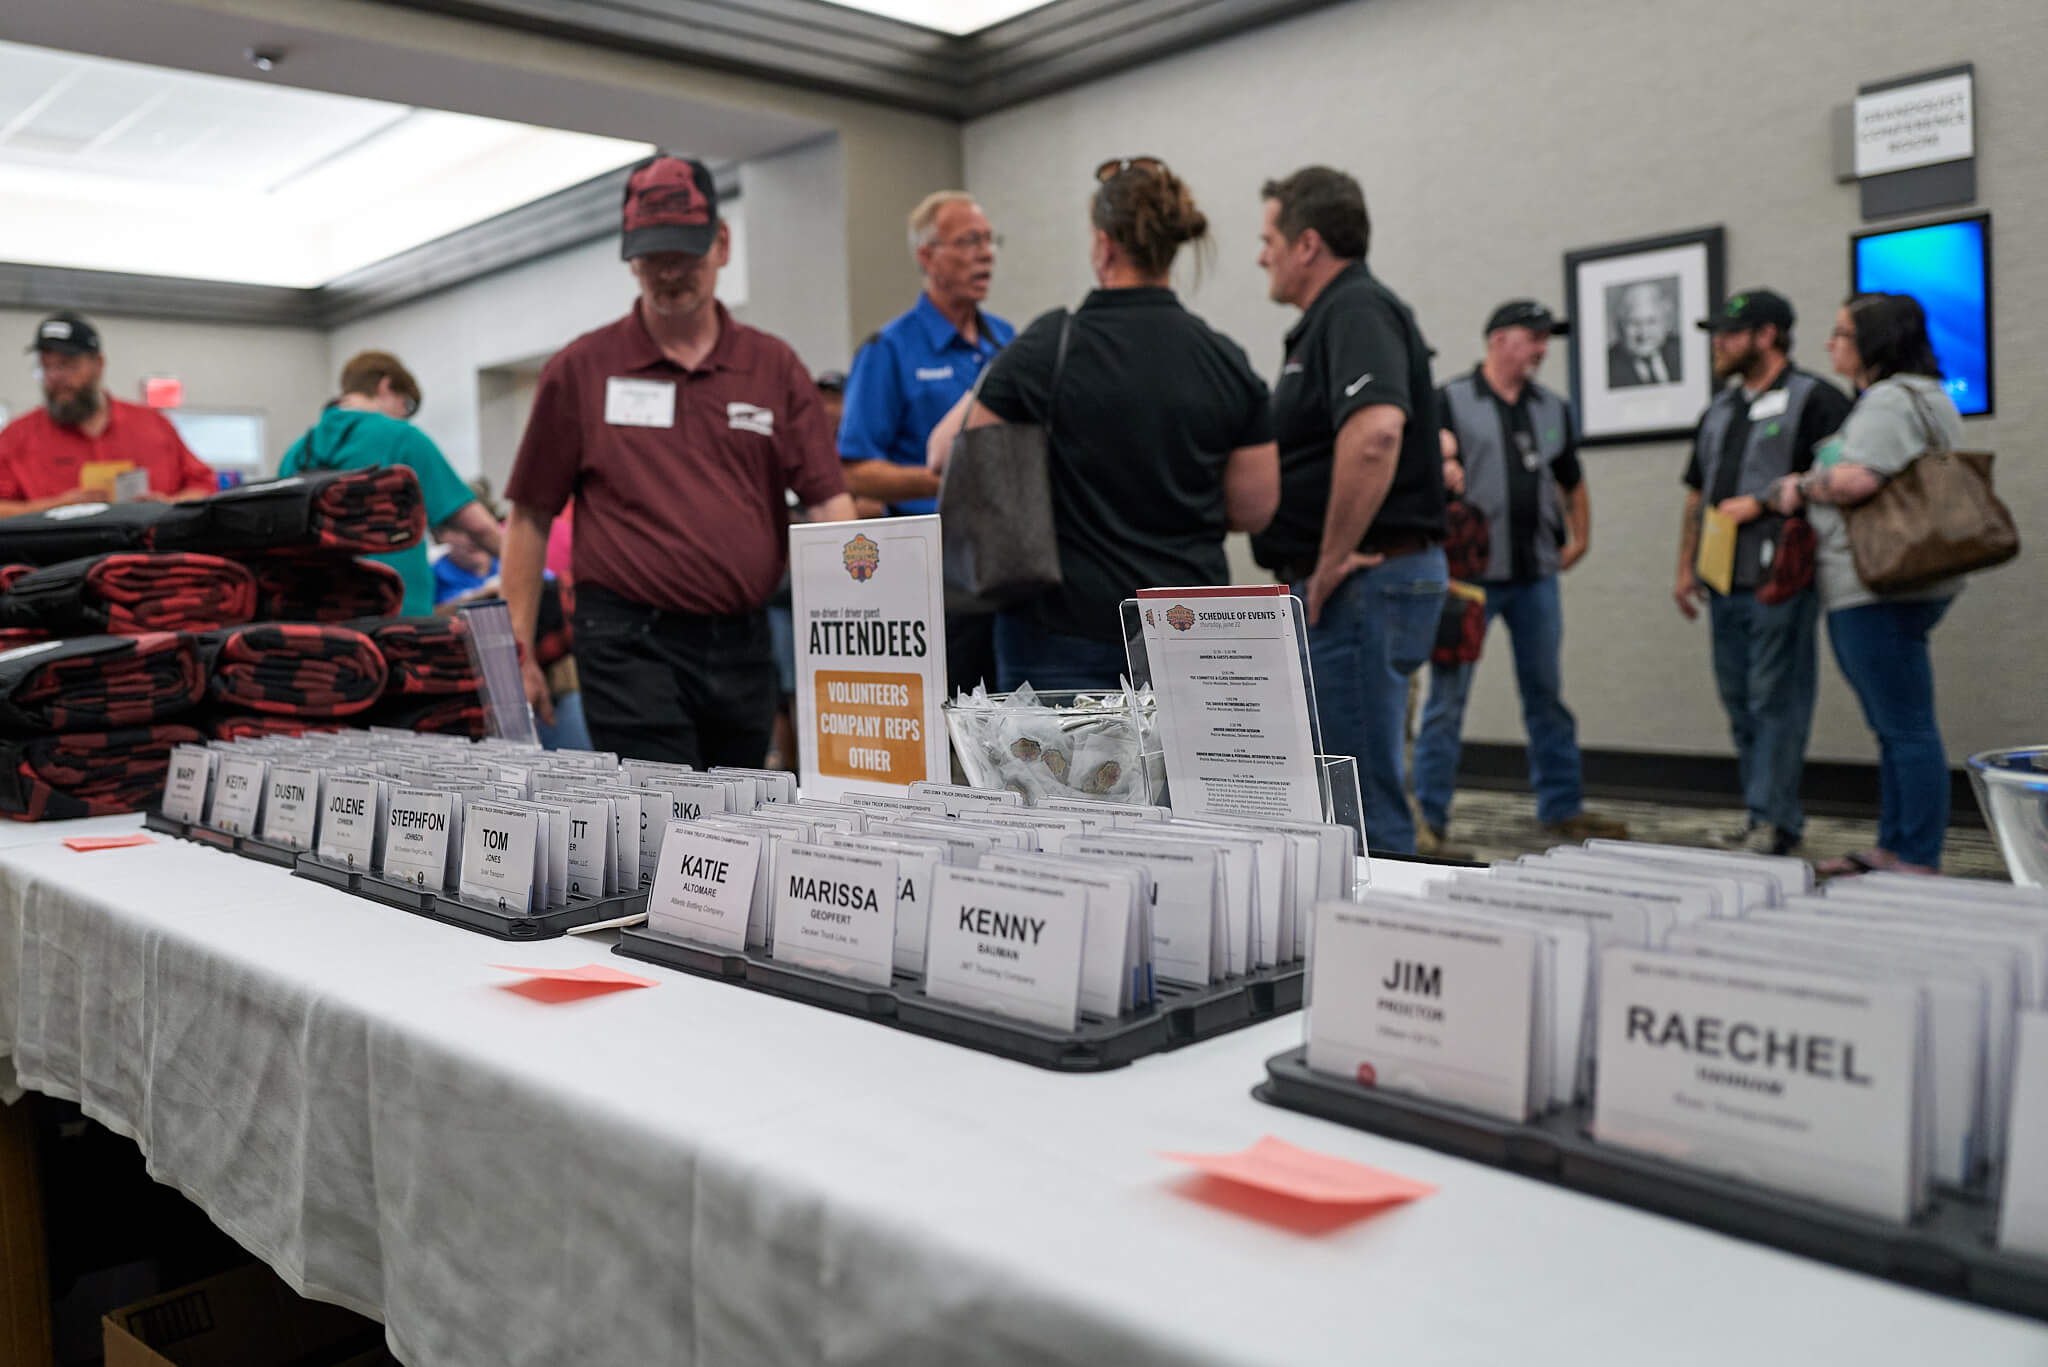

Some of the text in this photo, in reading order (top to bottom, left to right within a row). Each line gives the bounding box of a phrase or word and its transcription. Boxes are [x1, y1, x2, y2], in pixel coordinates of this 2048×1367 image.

[845, 608, 861, 618] driver
[1199, 611, 1276, 621] SCHEDULE OF EVENTS
[809, 620, 927, 658] ATTENDEES
[828, 682, 909, 706] VOLUNTEERS
[820, 712, 920, 742] COMPANY REPS
[849, 747, 891, 772] OTHER
[225, 775, 249, 791] KEITH
[275, 783, 305, 802] DUSTIN
[330, 796, 365, 816] JOLENE
[673, 802, 701, 820] RIKA
[391, 809, 445, 831] STEPHFON
[483, 828, 509, 851] TOM
[486, 854, 501, 864] JONES
[680, 854, 729, 884] KATIE
[683, 882, 717, 898] ALTOMARE
[789, 874, 879, 913] MARISSA
[703, 903, 724, 918] Company
[810, 908, 852, 925] GEOPFERT
[821, 929, 834, 941] Truck
[959, 904, 1046, 946] KENNY
[1382, 959, 1442, 998] JIM
[1626, 1004, 1875, 1088] RAECHEL
